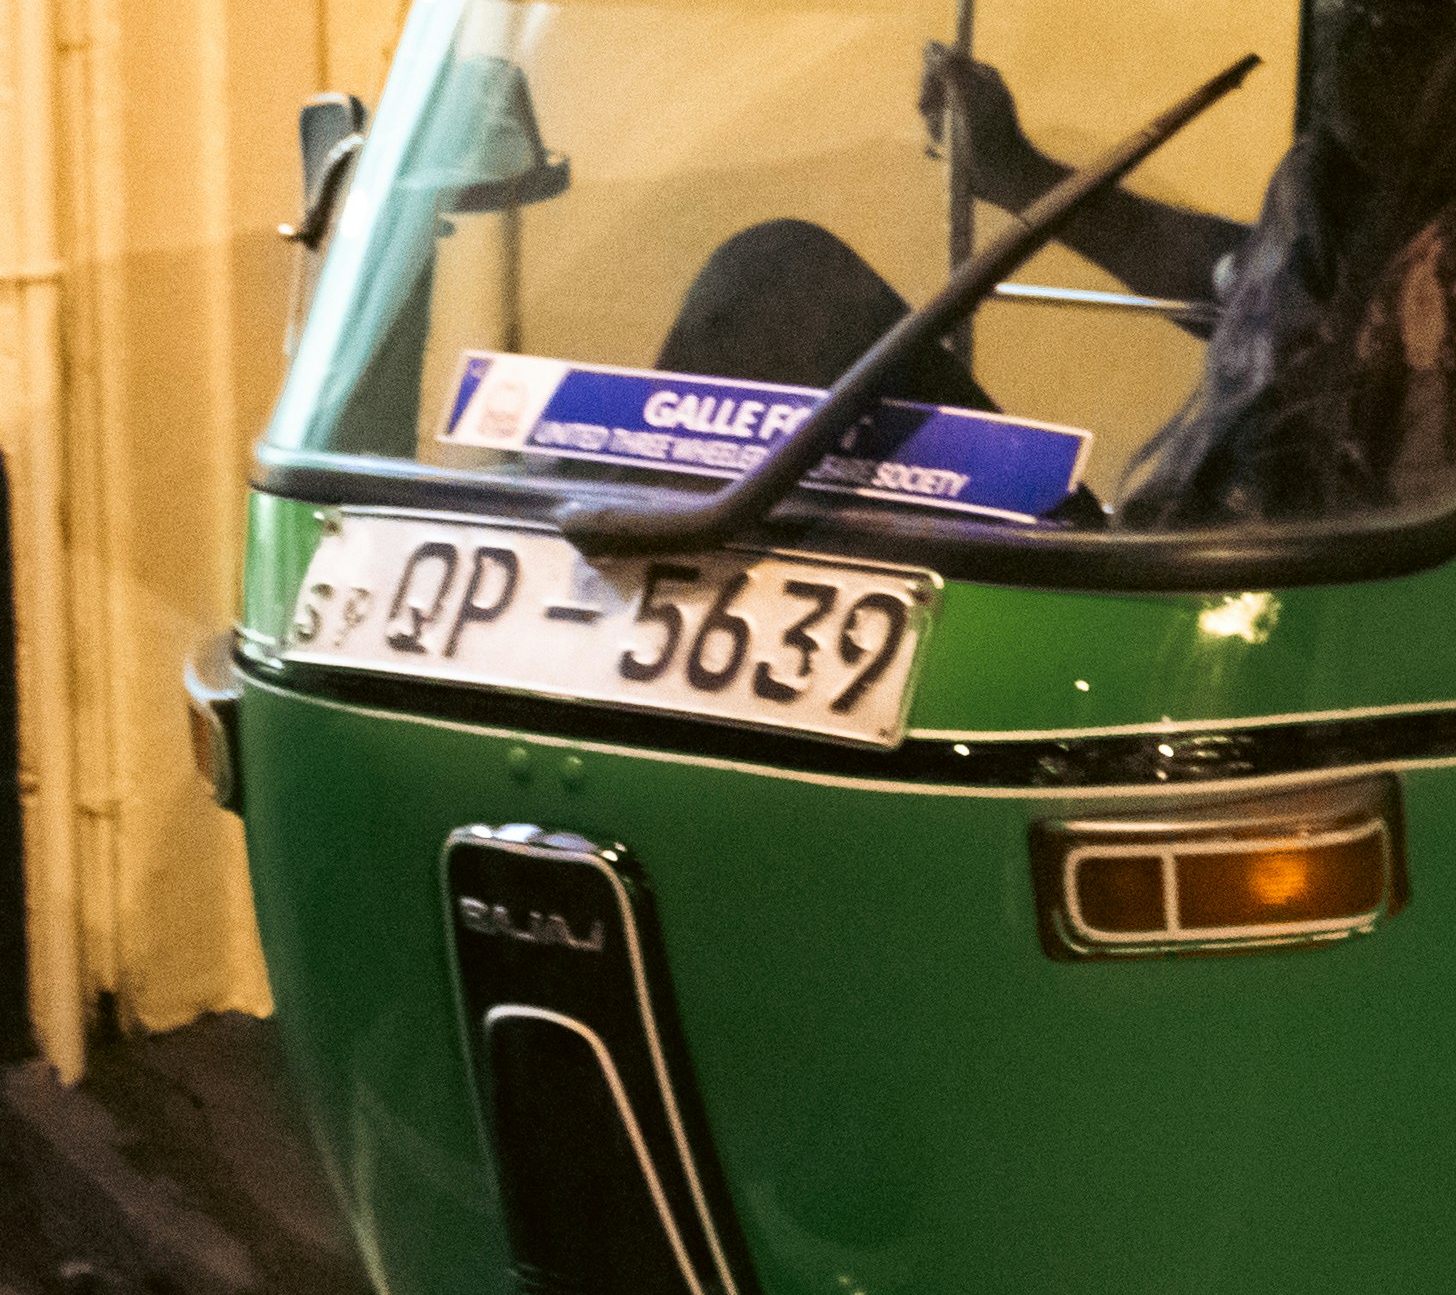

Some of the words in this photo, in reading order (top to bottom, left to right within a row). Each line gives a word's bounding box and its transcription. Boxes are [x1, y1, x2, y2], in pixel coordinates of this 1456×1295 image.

[644, 390, 764, 438] GALLE
[534, 420, 609, 450] UNITED
[609, 427, 671, 459] THREE
[872, 461, 971, 497] SOCIETY
